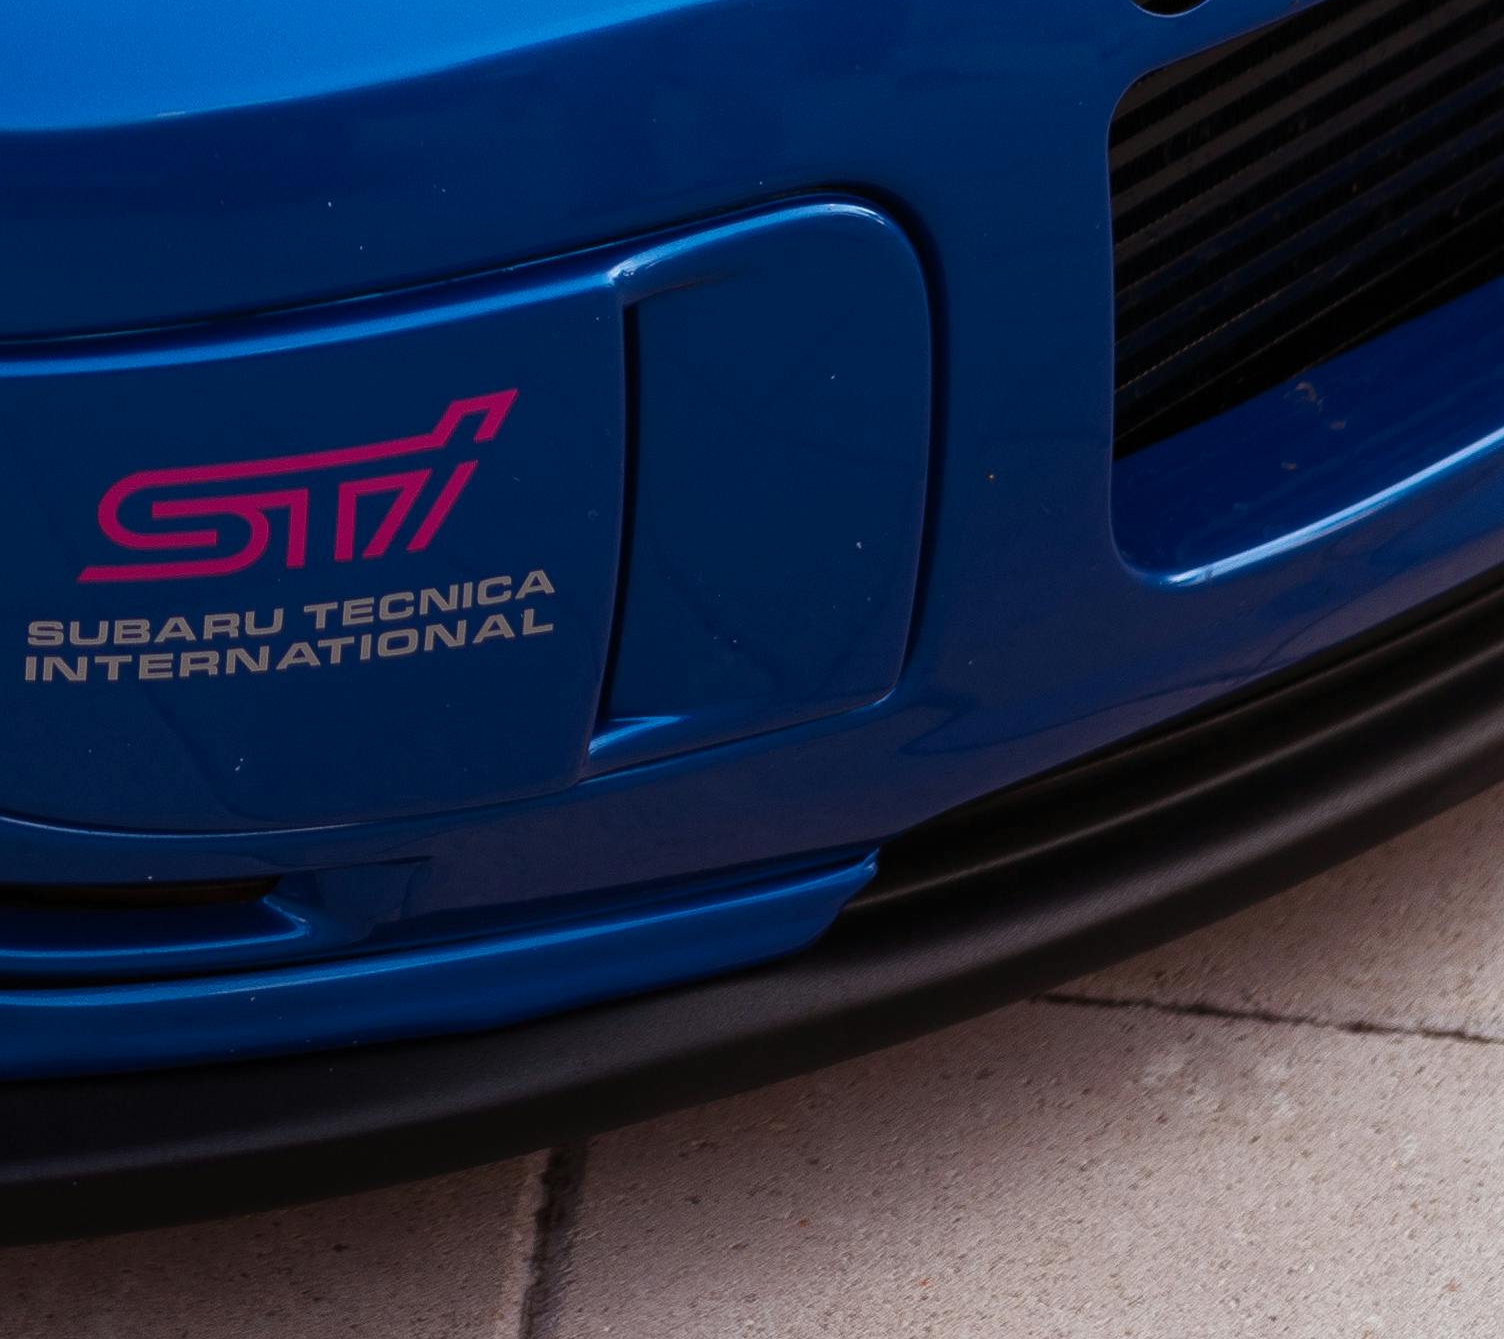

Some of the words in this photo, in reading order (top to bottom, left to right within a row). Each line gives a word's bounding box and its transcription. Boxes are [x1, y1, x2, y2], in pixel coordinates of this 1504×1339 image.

[24, 607, 555, 682] INTERNATIONAL
[27, 608, 285, 646] SUBARU
[303, 569, 556, 630] TECNICA
